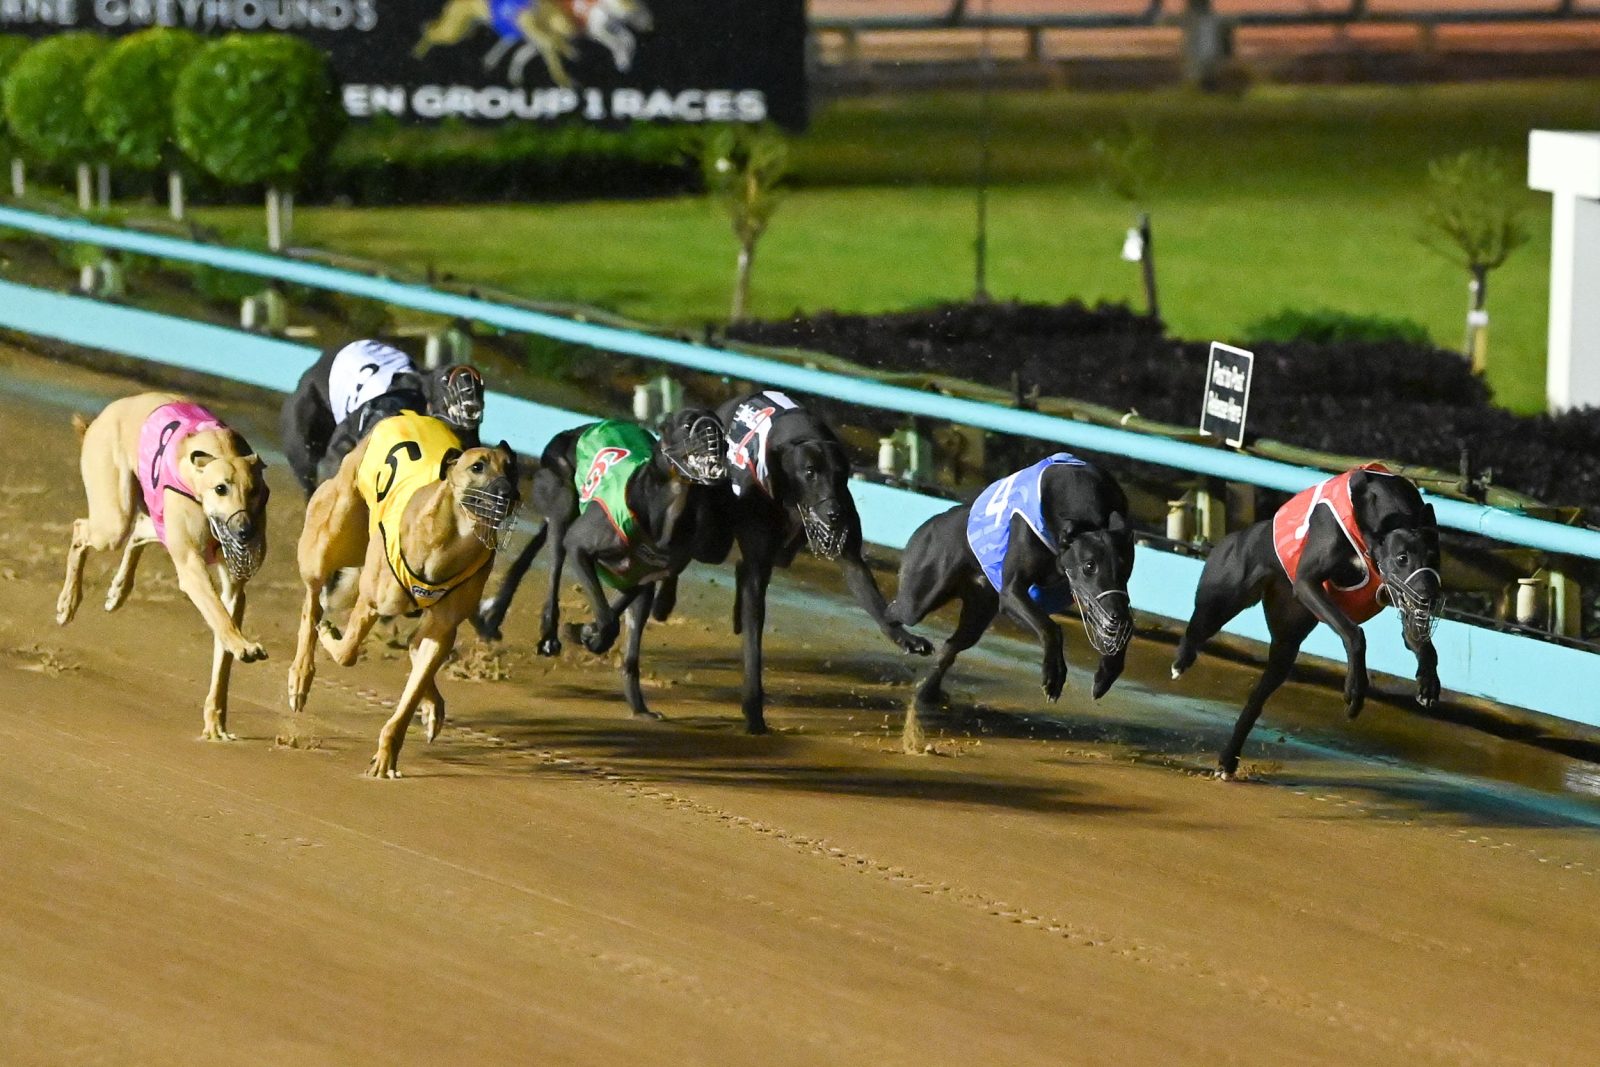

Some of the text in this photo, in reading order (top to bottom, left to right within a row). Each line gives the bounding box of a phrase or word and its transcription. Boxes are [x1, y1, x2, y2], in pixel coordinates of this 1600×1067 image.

[95, 0, 378, 31] GREYHOUNDS
[343, 84, 767, 122] EN GROUP 1 RACES
[151, 420, 181, 489] 8
[376, 441, 422, 503] 5
[579, 446, 631, 502] 6
[984, 470, 1021, 528] 4
